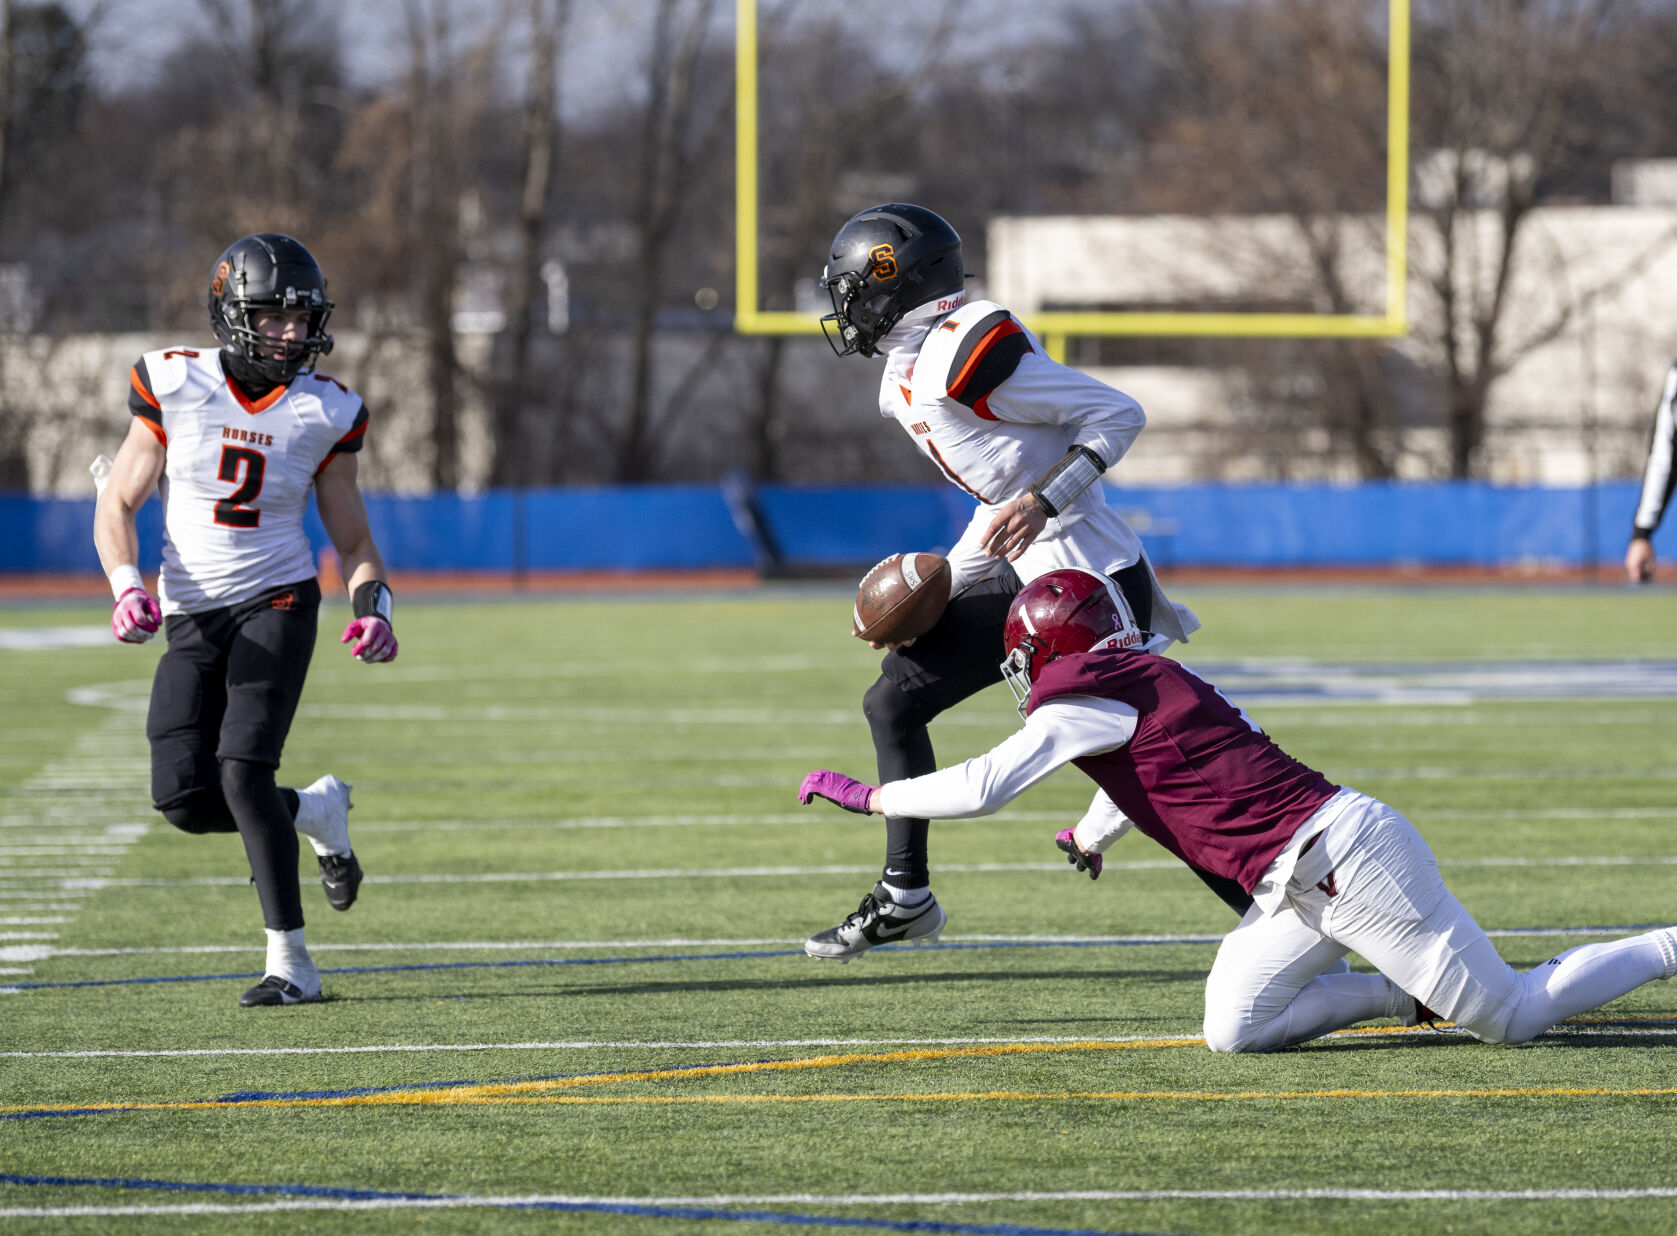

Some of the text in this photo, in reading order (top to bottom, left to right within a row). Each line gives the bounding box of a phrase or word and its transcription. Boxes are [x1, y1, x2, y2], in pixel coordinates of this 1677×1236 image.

[868, 242, 899, 281] S
[222, 426, 274, 446] HORSES
[213, 444, 266, 528] 2
[1018, 603, 1038, 636] 1
